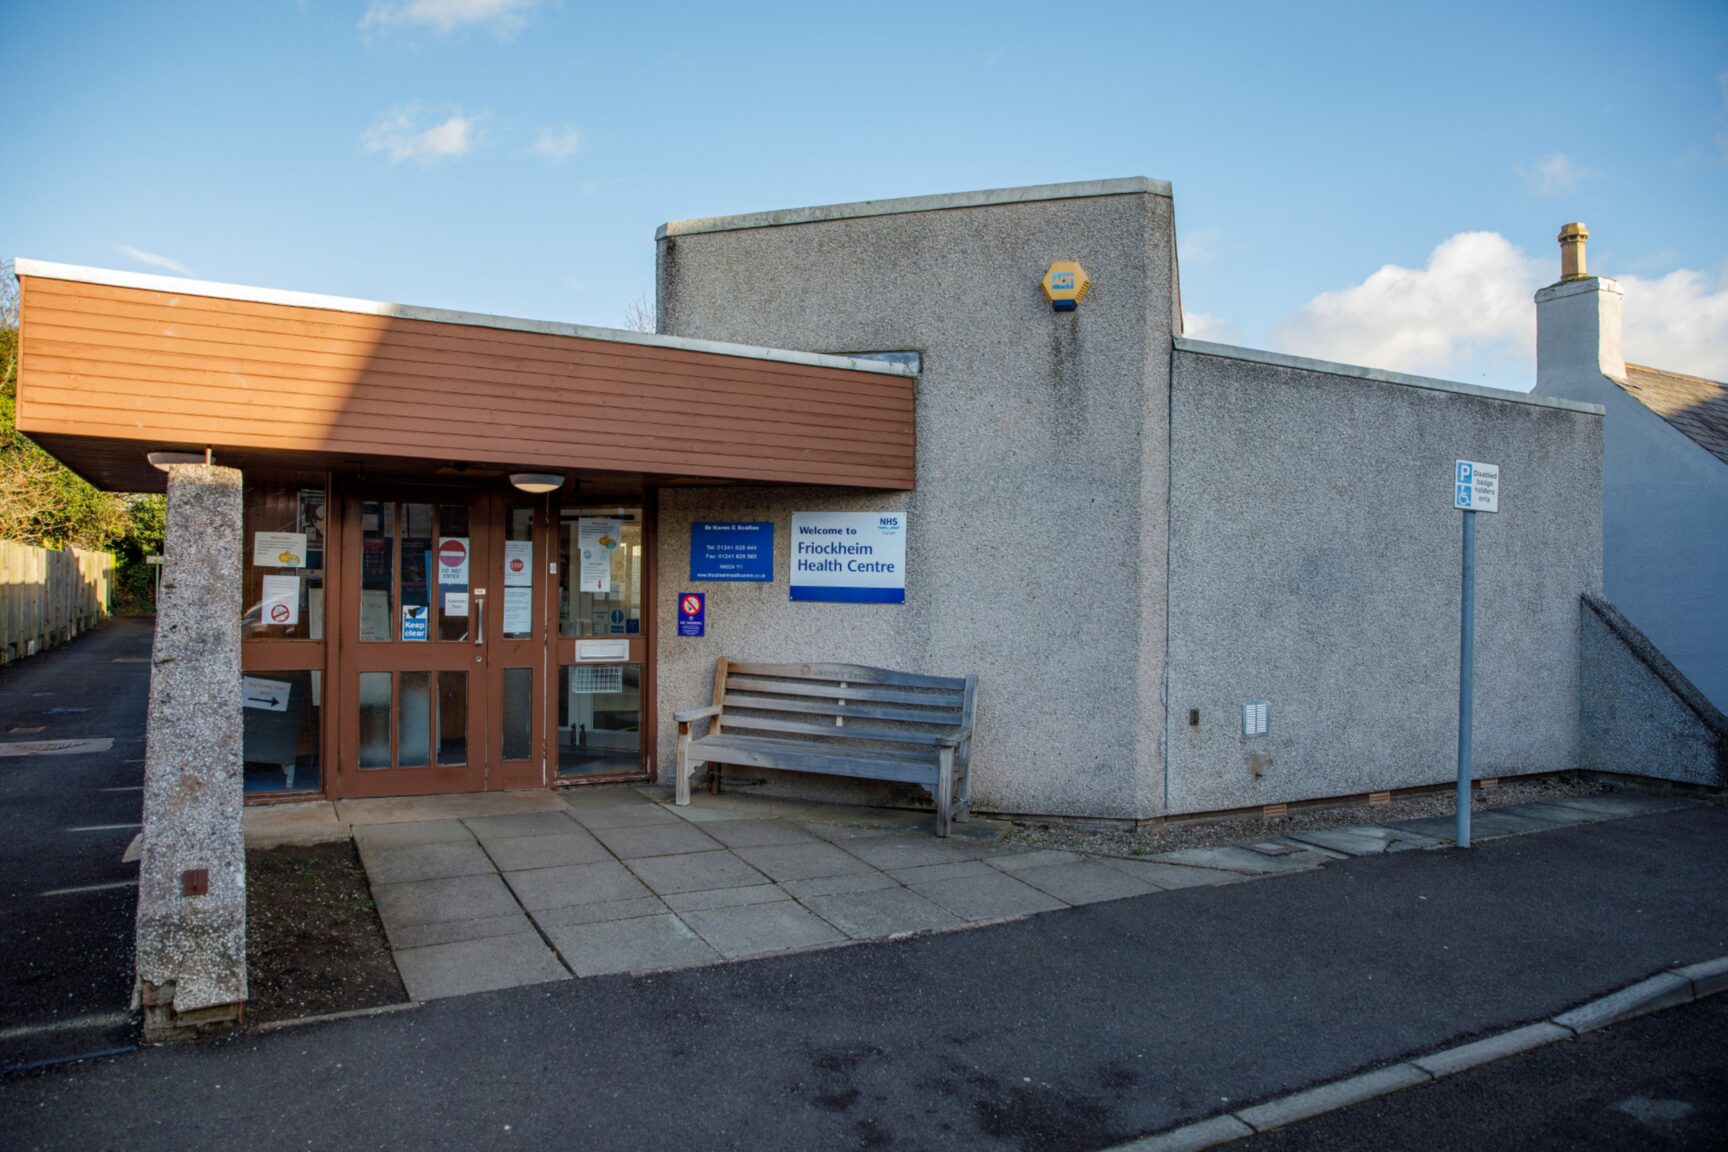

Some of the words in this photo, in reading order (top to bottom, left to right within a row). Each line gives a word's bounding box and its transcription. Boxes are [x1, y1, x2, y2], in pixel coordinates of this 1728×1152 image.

[1461, 465, 1470, 481] P
[1474, 470, 1497, 479] Disabled
[1477, 479, 1493, 487] badge
[1475, 487, 1494, 495] holders
[880, 518, 898, 526] NHS
[800, 526, 843, 535] Welcome
[798, 542, 873, 555] Friockheim
[798, 559, 842, 572] Health
[847, 560, 895, 573] Centre
[405, 622, 425, 630] Keep
